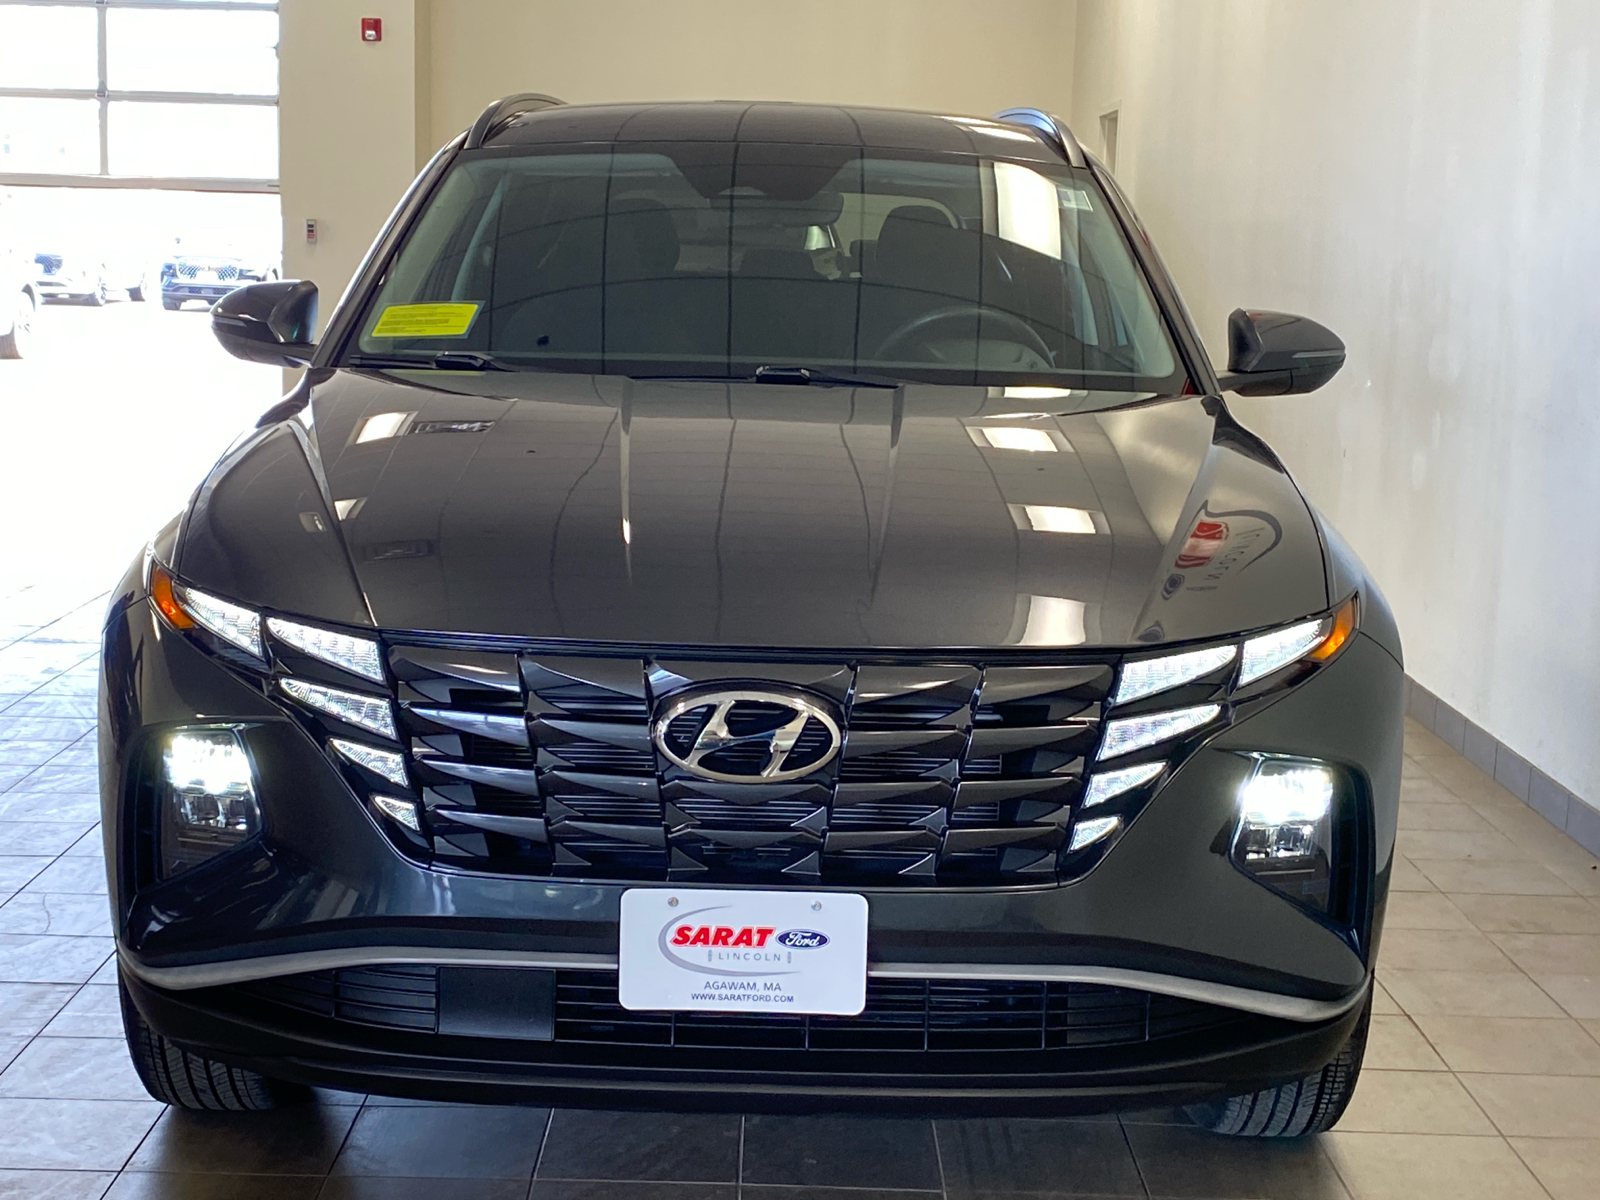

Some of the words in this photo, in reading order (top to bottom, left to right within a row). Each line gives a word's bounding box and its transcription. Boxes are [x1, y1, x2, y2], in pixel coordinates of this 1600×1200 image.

[671, 924, 774, 948] SARAT
[785, 930, 820, 947] Ford
[718, 952, 781, 962] LINCOLN
[704, 981, 760, 993] AGAWAM,
[763, 982, 782, 993] MA
[691, 993, 794, 1003] WWW.SARATFORD.COM
